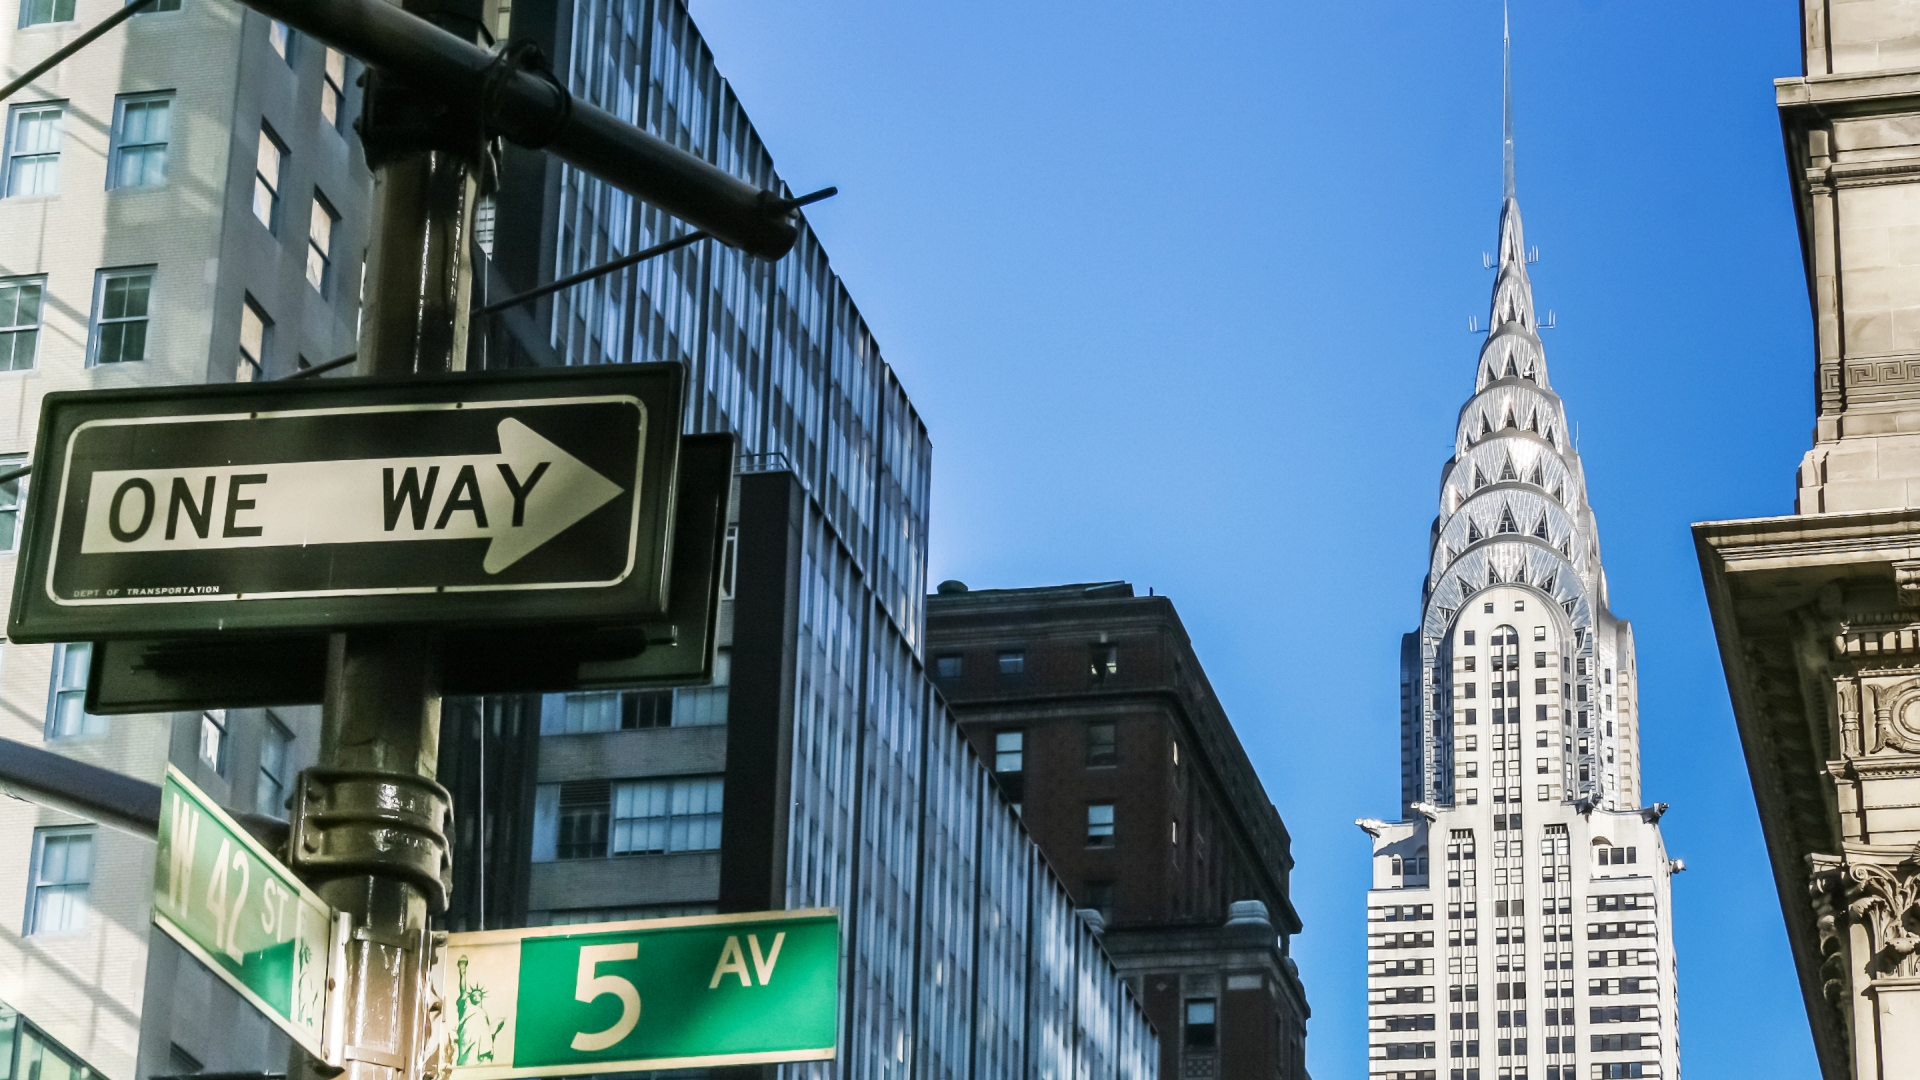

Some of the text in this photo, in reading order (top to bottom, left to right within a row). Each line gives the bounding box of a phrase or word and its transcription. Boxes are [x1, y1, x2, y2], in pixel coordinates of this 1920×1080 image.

[109, 462, 551, 543] ONE WAY
[73, 585, 220, 598] DEPT OF TRANSPORTATION
[169, 792, 289, 966] W 42 ST
[570, 932, 786, 1051] 5 AV
